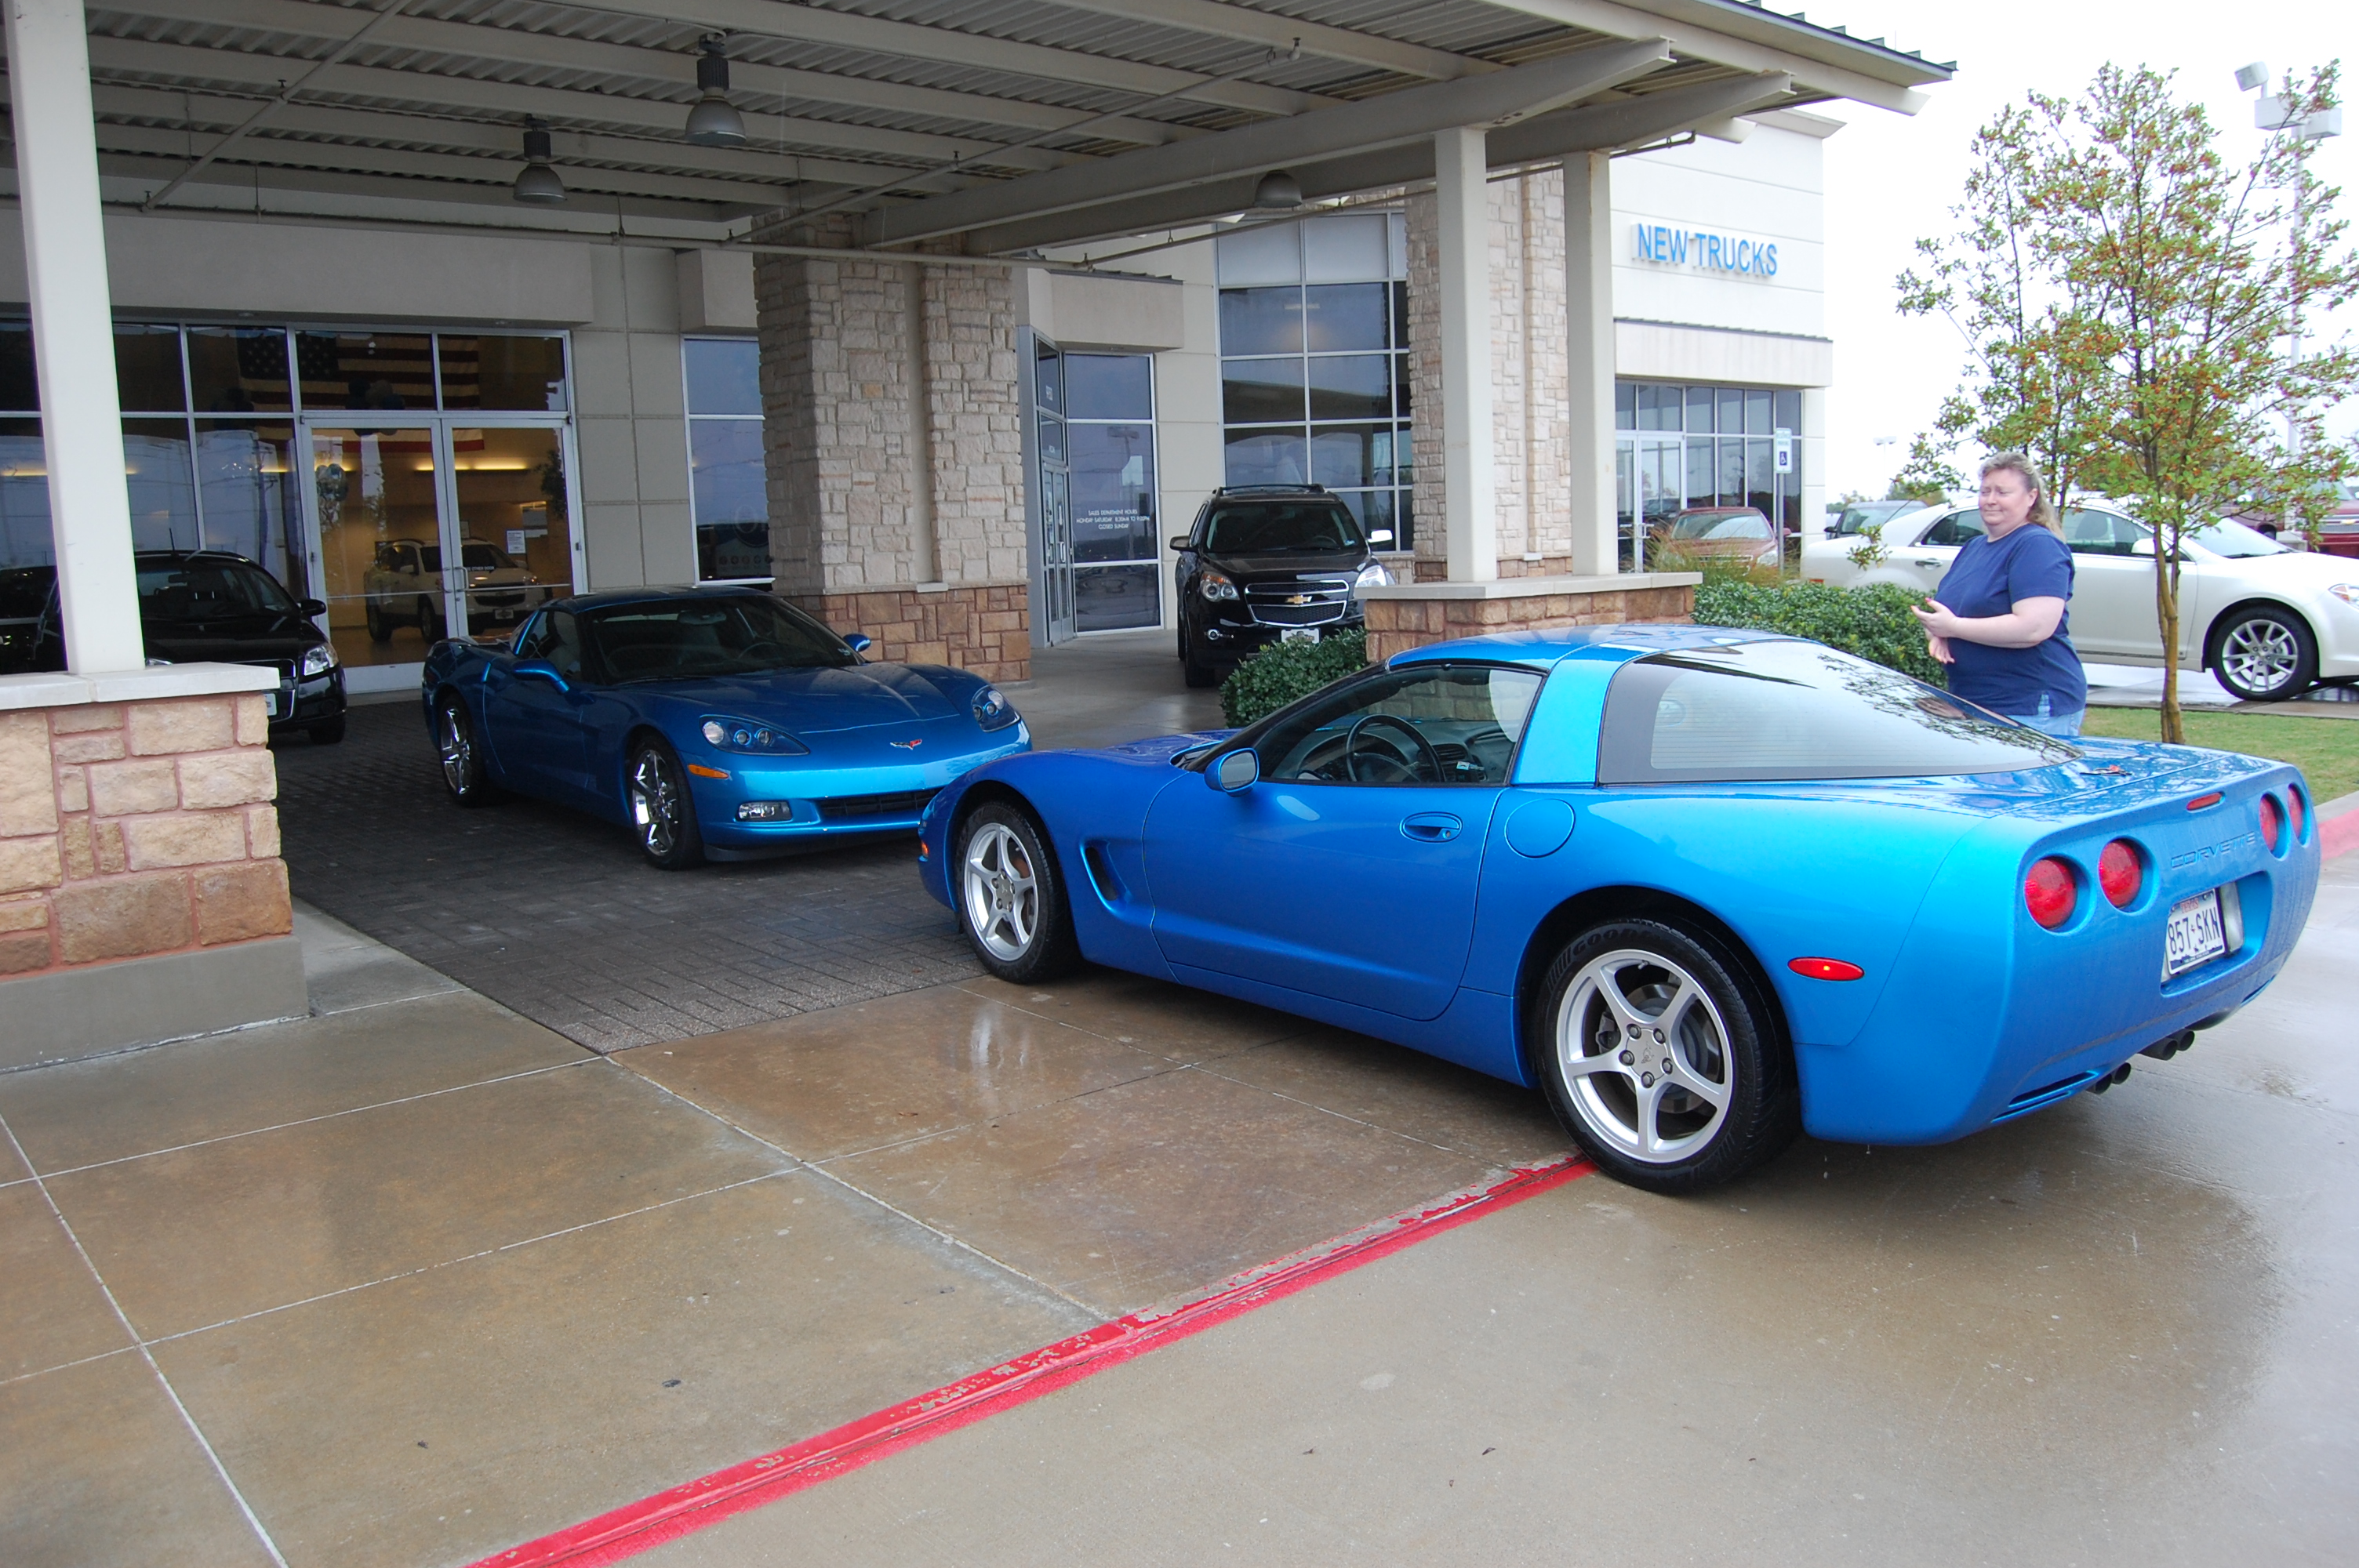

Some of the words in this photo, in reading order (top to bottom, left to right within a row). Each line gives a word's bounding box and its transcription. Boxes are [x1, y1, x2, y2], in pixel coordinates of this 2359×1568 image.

[1637, 223, 1688, 264] NEW
[1694, 233, 1778, 276] TRUCKS
[2170, 831, 2256, 870] CORVETTE
